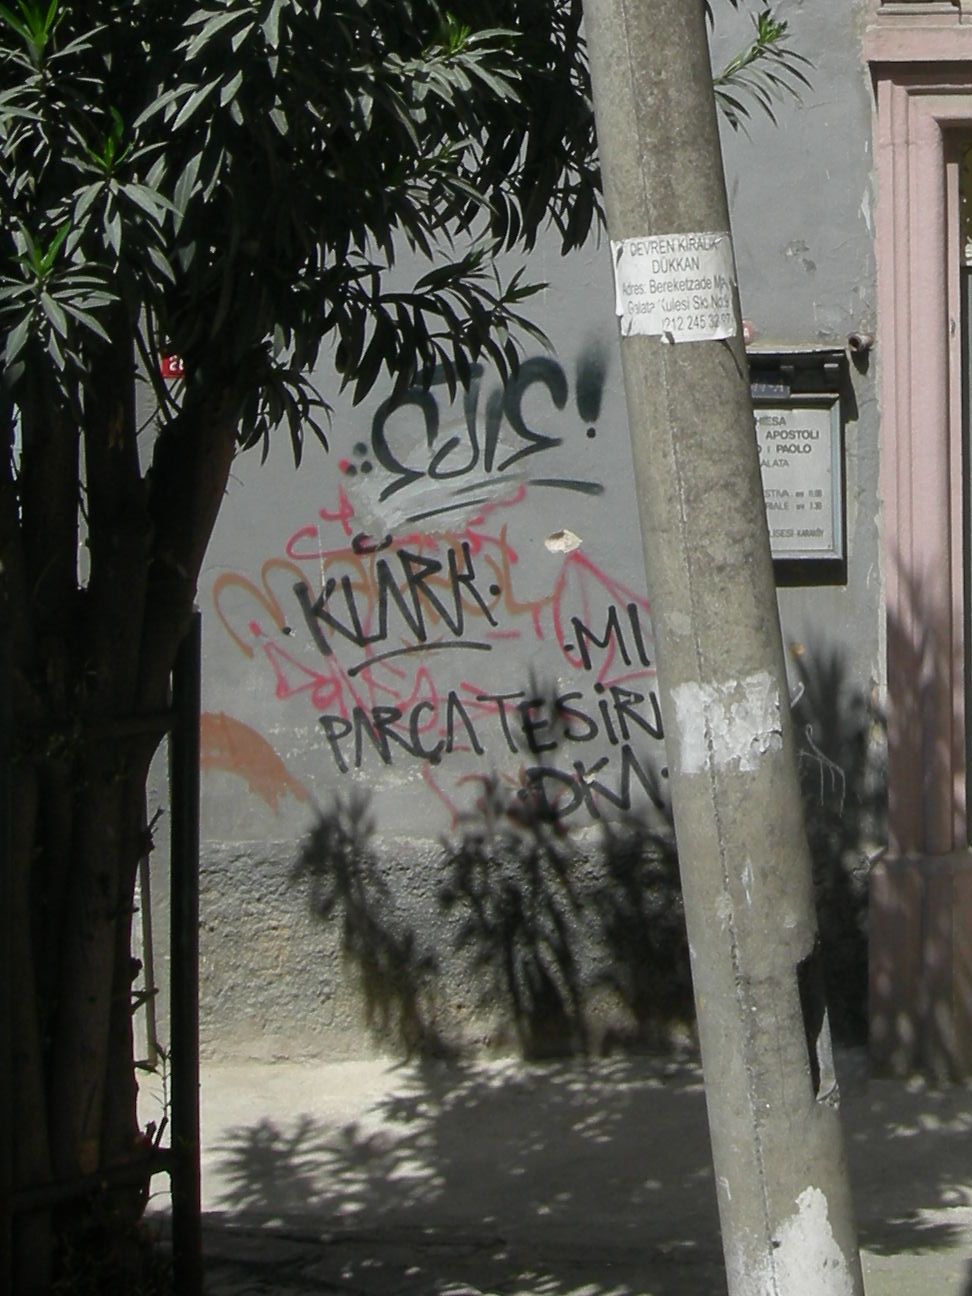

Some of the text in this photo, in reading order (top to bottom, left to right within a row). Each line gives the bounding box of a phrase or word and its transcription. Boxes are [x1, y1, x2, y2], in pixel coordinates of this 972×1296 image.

[630, 239, 675, 257] DEVREN
[765, 429, 820, 441] APOSTOLI
[775, 443, 813, 454] PAOLO
[760, 458, 790, 468] ALATA
